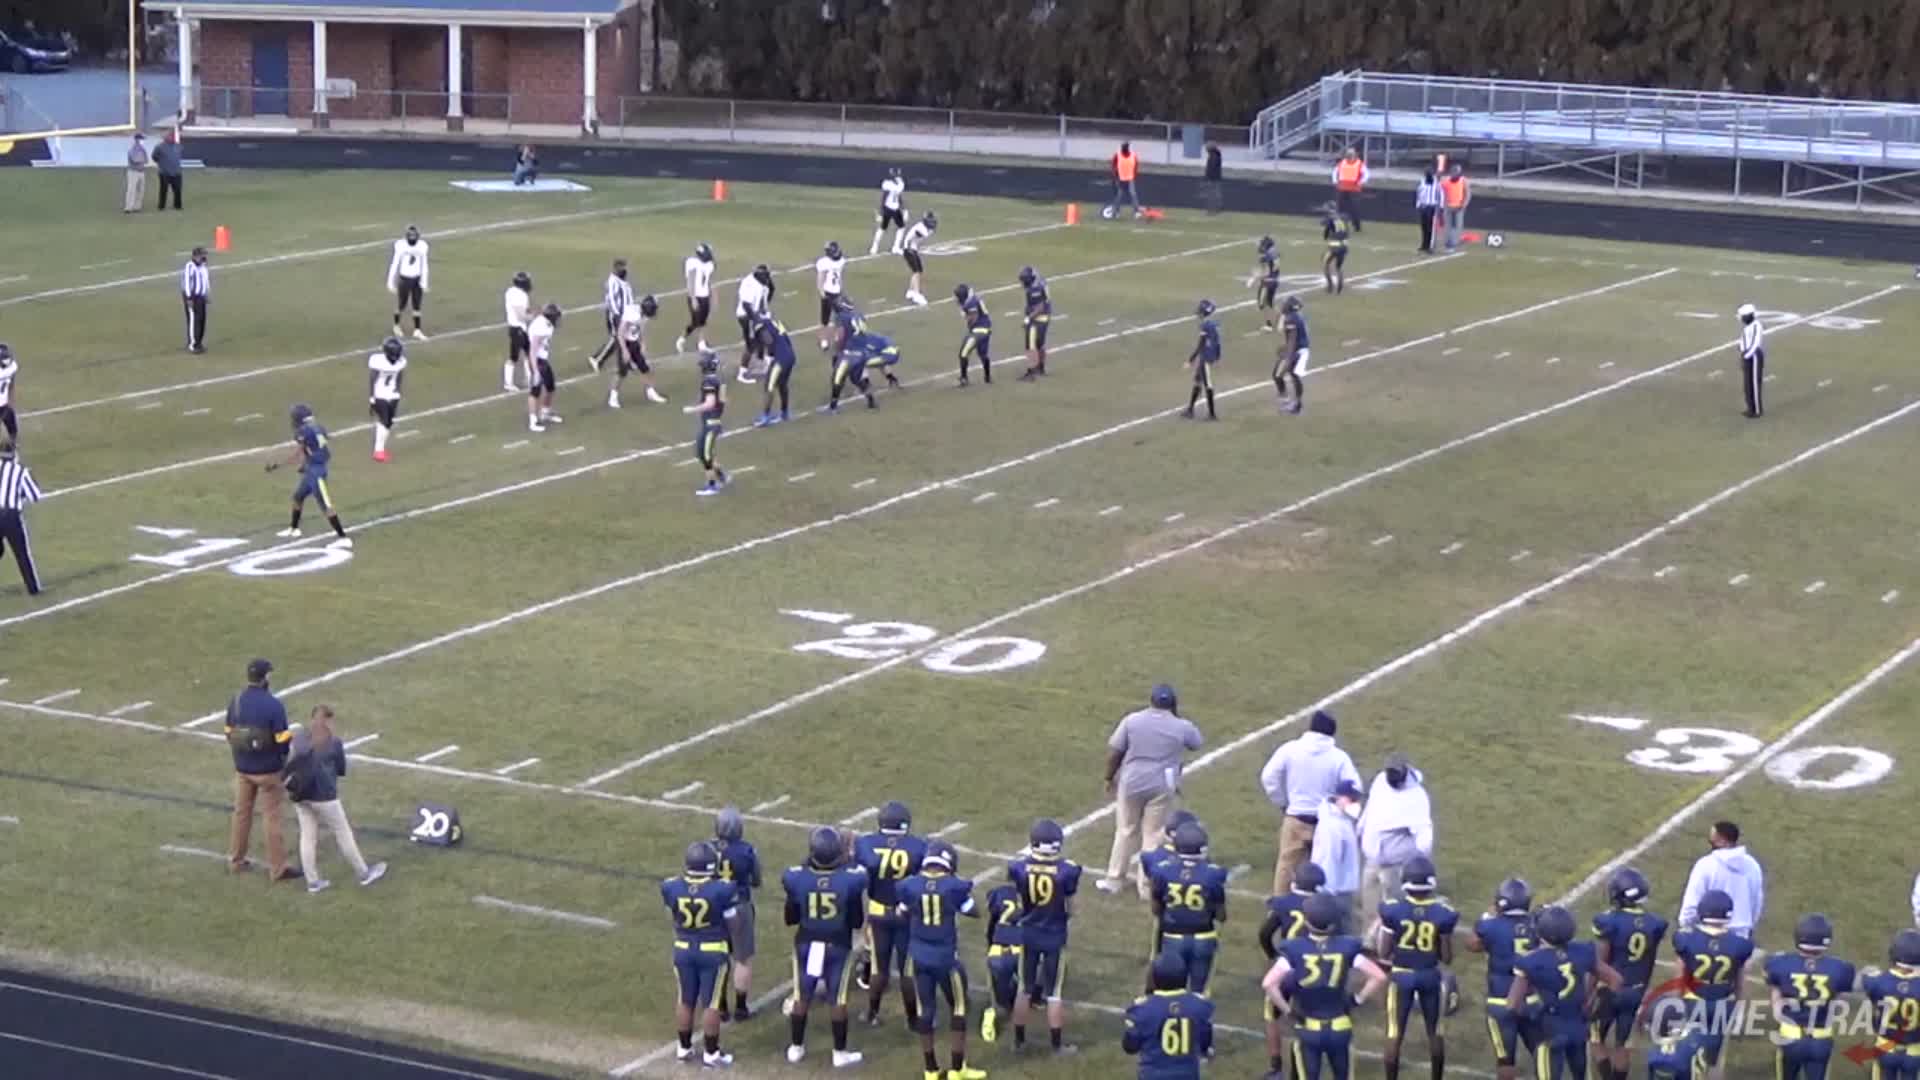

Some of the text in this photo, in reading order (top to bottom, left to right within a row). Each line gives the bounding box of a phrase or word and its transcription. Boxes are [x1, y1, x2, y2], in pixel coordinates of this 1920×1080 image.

[791, 621, 1047, 673] 20
[1624, 726, 1894, 789] 30
[413, 807, 449, 837] 20
[873, 848, 908, 879] 79
[807, 891, 837, 919] 15
[1028, 873, 1054, 906] 19
[1166, 882, 1206, 912] 36
[676, 897, 712, 929] 52
[921, 894, 941, 926] 11
[1398, 919, 1436, 951] 28
[1628, 931, 1647, 962] 9
[1298, 952, 1343, 988] 37
[1557, 961, 1576, 1000] 3
[1693, 953, 1732, 985] 22
[1789, 973, 1830, 1002] 33
[1883, 995, 1919, 1031] 29
[1161, 1017, 1190, 1057] 61
